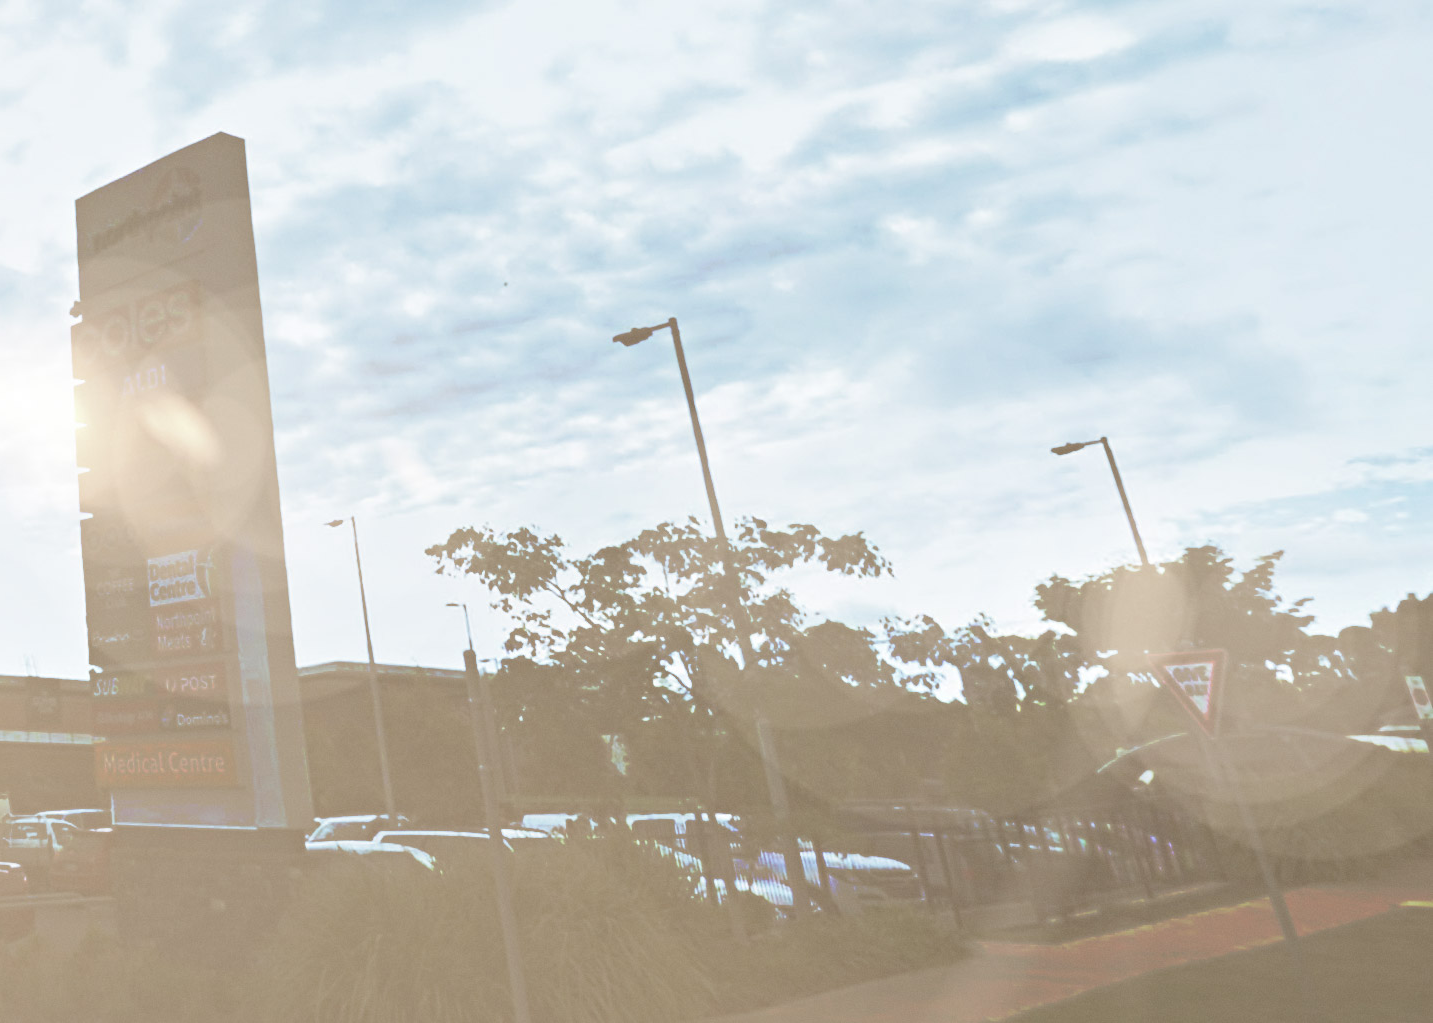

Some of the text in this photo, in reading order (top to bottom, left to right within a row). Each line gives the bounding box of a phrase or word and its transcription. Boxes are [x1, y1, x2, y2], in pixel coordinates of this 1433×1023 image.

[149, 554, 194, 581] Dental
[149, 580, 196, 601] Centre
[157, 634, 192, 651] Meats
[180, 675, 216, 693] POST
[103, 751, 226, 774] Medical Centre
